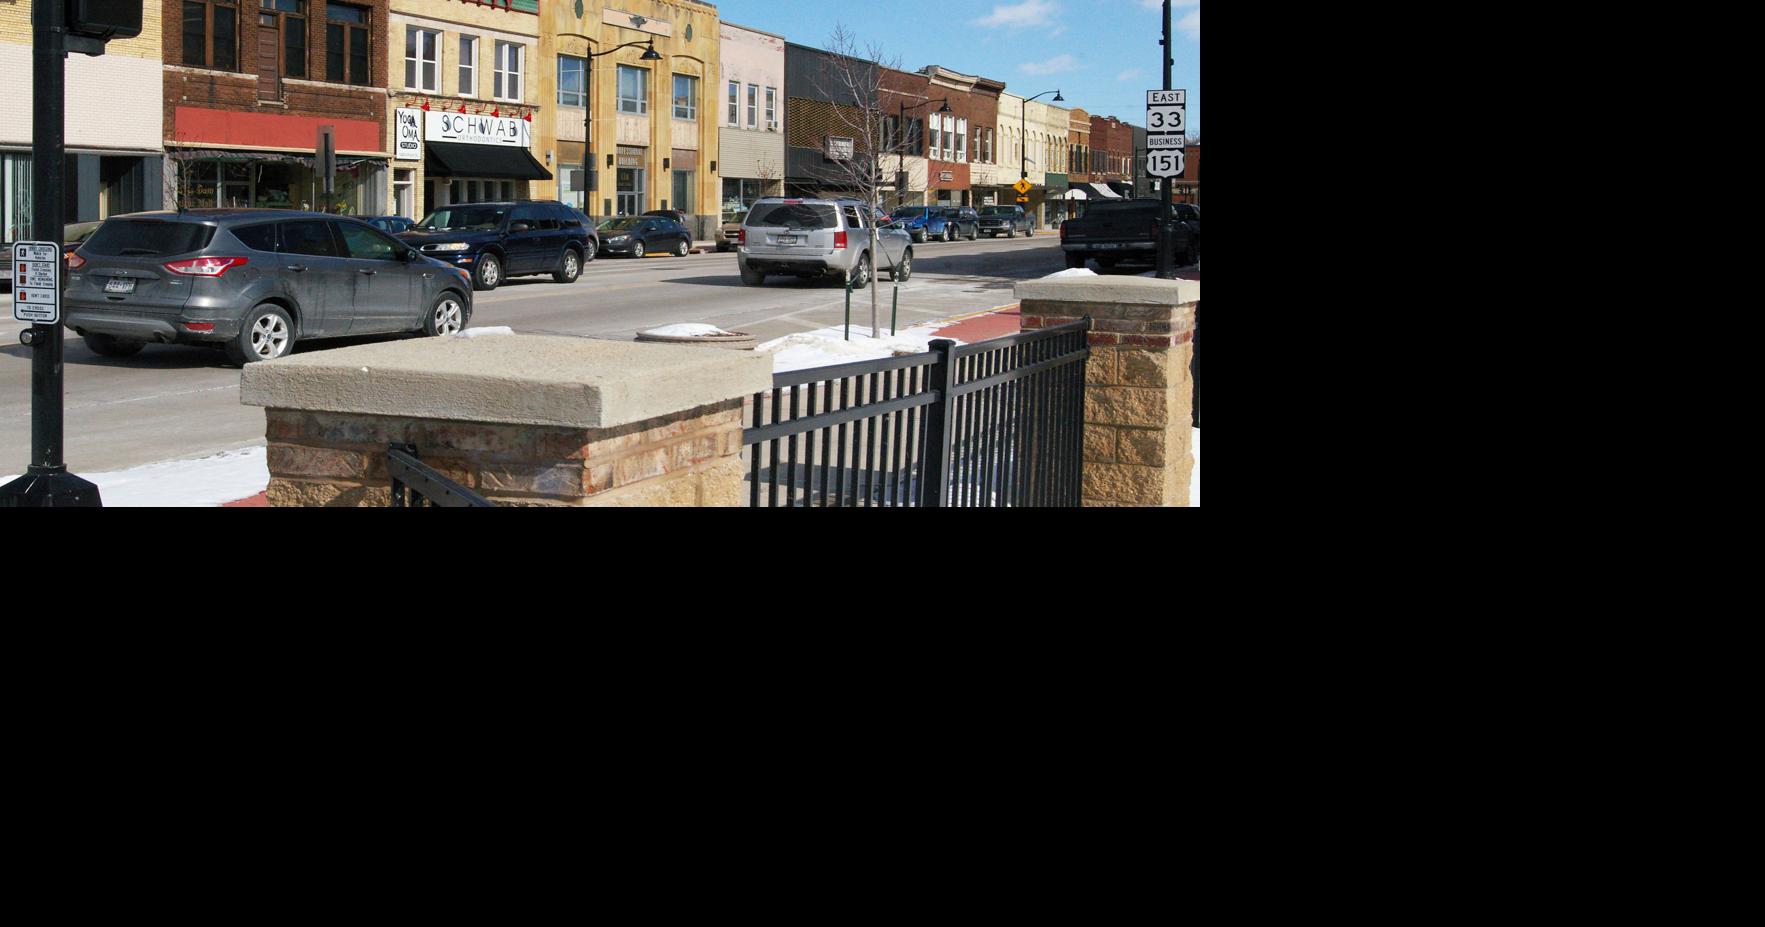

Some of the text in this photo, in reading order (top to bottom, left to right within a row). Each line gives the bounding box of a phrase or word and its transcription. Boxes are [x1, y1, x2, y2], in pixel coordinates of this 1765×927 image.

[1152, 92, 1181, 102] EAST
[441, 114, 518, 137] SCHWAB
[1150, 112, 1182, 128] 33
[402, 125, 420, 142] OMA
[457, 135, 503, 144] ORTHODONTICS
[1149, 138, 1182, 146] BUSINESS
[1151, 155, 1179, 171] 151
